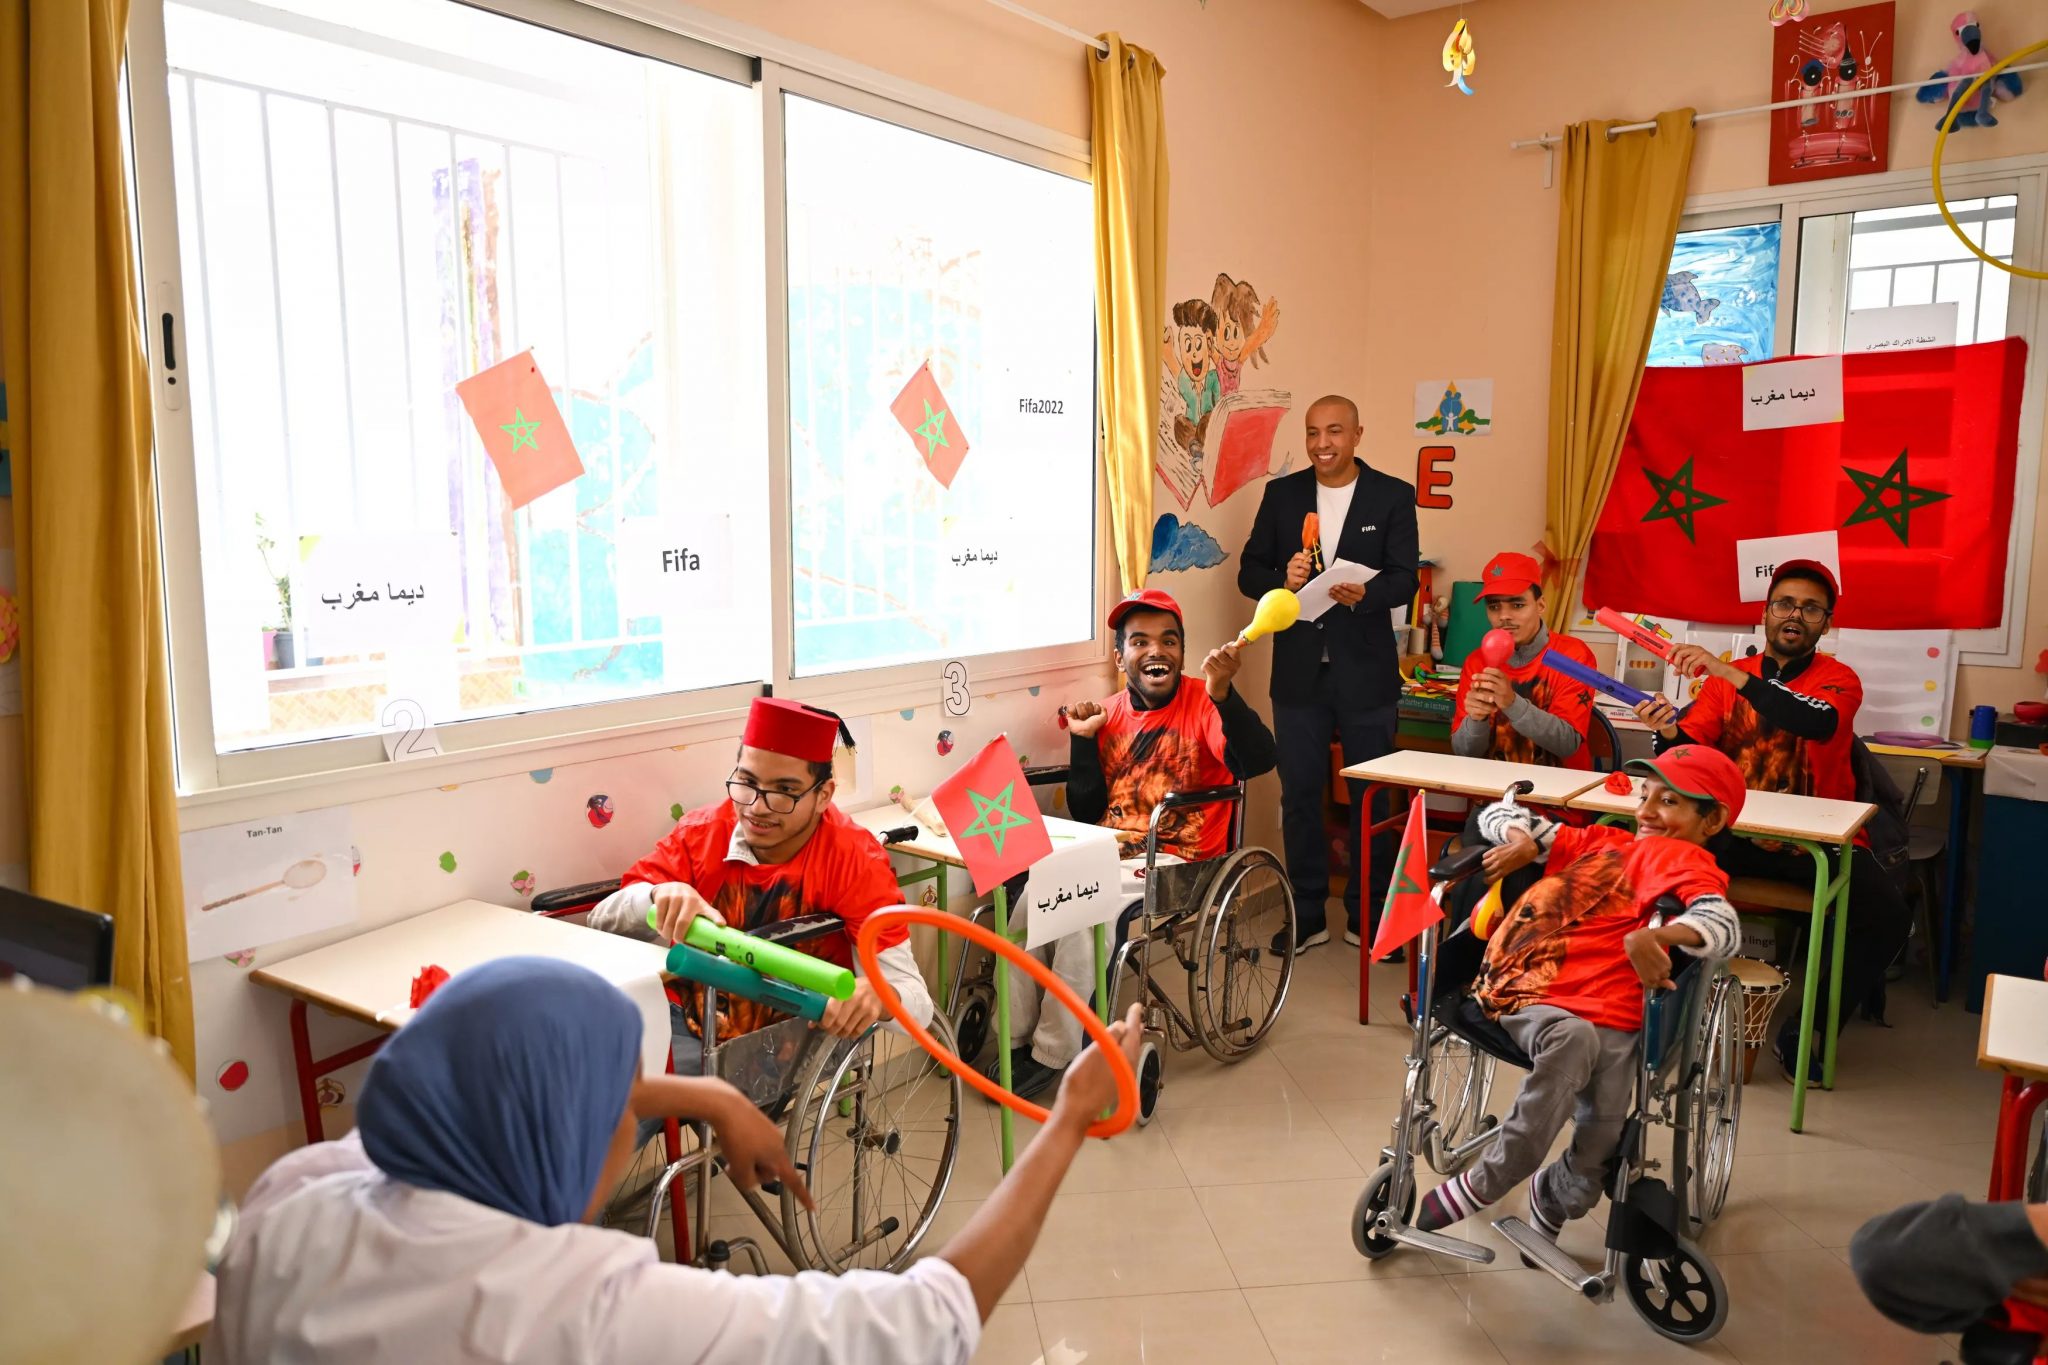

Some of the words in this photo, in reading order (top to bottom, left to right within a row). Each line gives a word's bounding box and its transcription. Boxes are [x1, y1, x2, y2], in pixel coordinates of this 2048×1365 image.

[1751, 389, 1785, 405] مغرب
[1790, 388, 1815, 401] ديما
[1019, 398, 1064, 414] Fifa2022
[1415, 446, 1456, 509] E
[1361, 525, 1376, 533] FIFA
[662, 547, 700, 572] Fifa
[951, 548, 978, 567] مغرب
[981, 548, 998, 565] ديما
[1755, 564, 1774, 578] Fif
[321, 583, 379, 610] مغرب
[387, 582, 425, 606] ديما
[943, 661, 971, 716] 3
[381, 698, 439, 762] 2
[246, 826, 283, 838] Tan-Tan
[1037, 887, 1073, 913] مغرب
[1077, 881, 1099, 900] ديما
